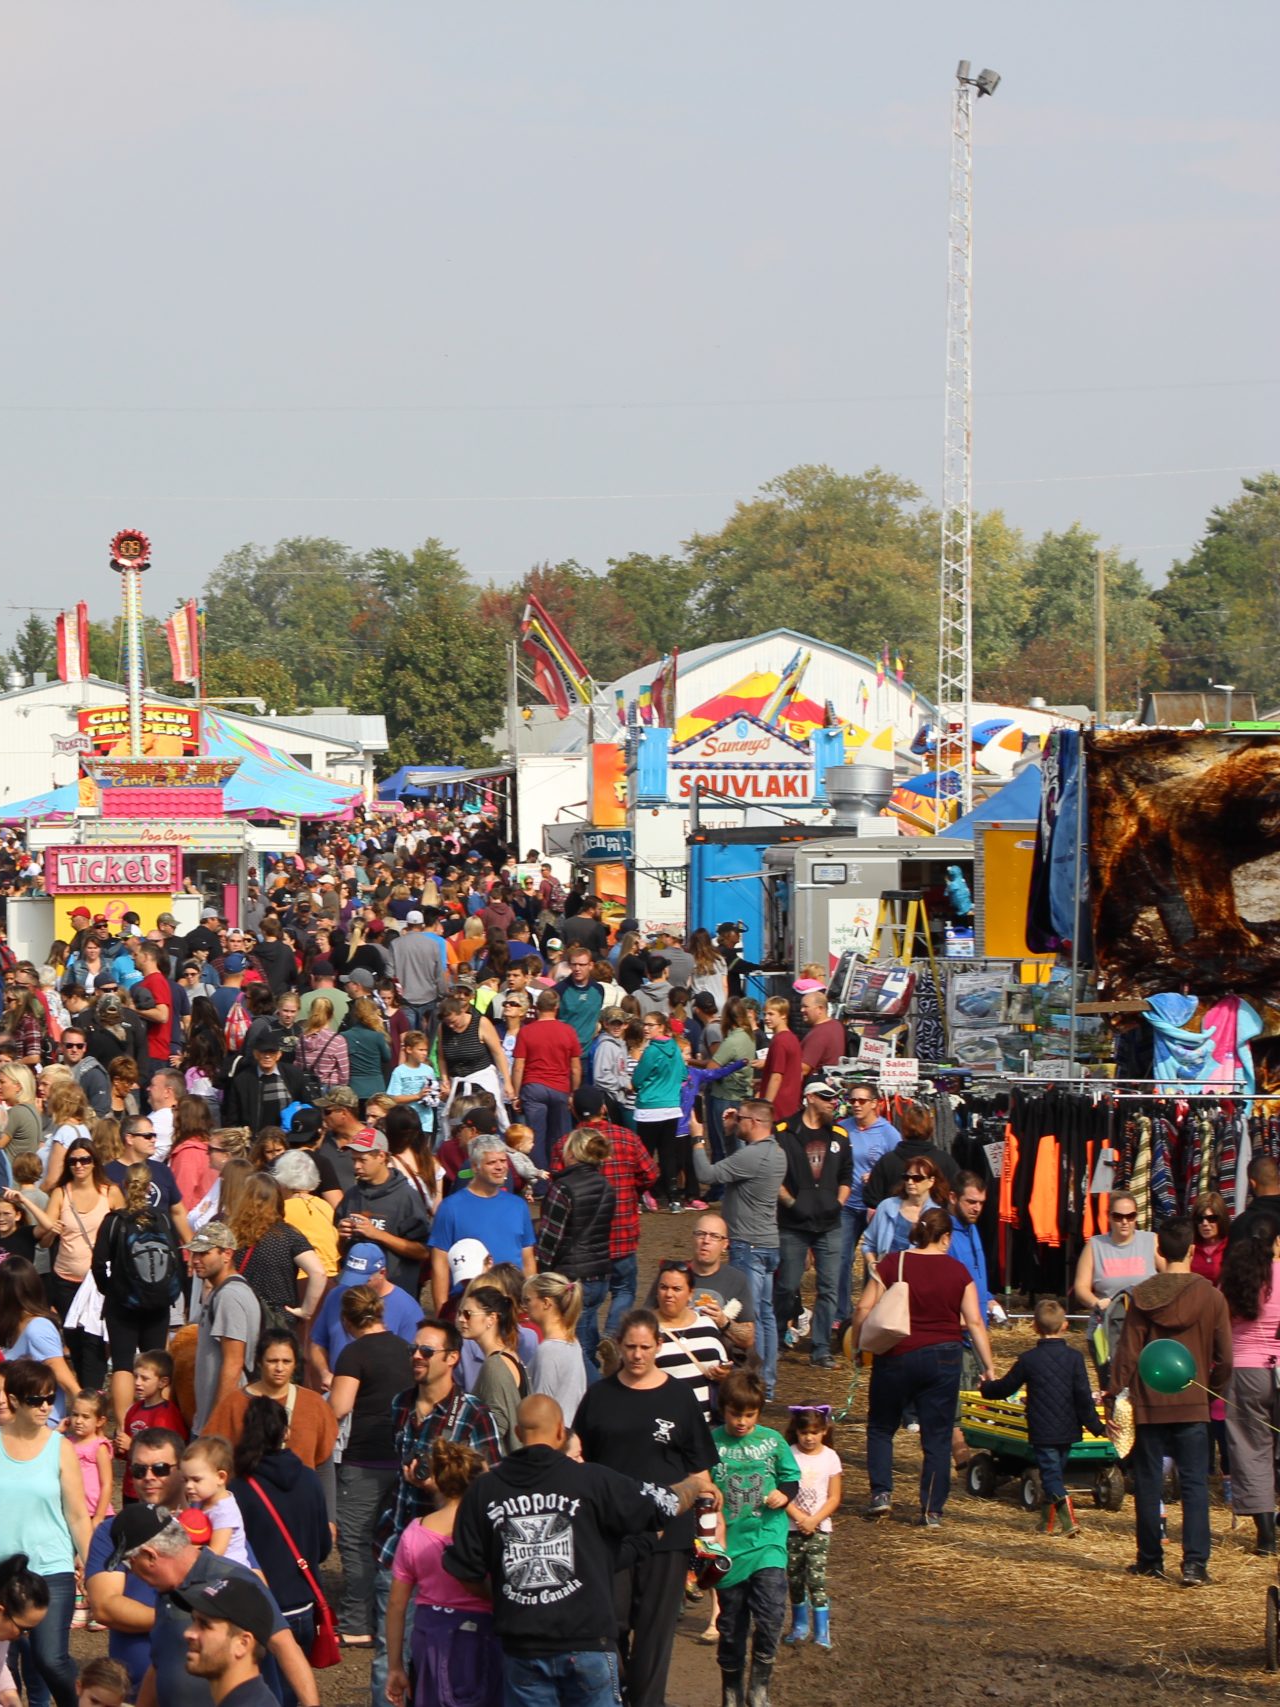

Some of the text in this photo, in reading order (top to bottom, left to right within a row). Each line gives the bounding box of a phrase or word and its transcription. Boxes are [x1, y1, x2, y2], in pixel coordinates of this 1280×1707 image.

[88, 710, 189, 725] CHIKEN
[701, 737, 772, 757] Sammy's
[112, 773, 222, 787] Candy Factory
[679, 774, 808, 798] SOUVLAKI
[140, 830, 192, 842] Pop Corn
[61, 855, 170, 884] Tickets
[486, 1493, 580, 1529] Support
[539, 1579, 583, 1604] Canada
